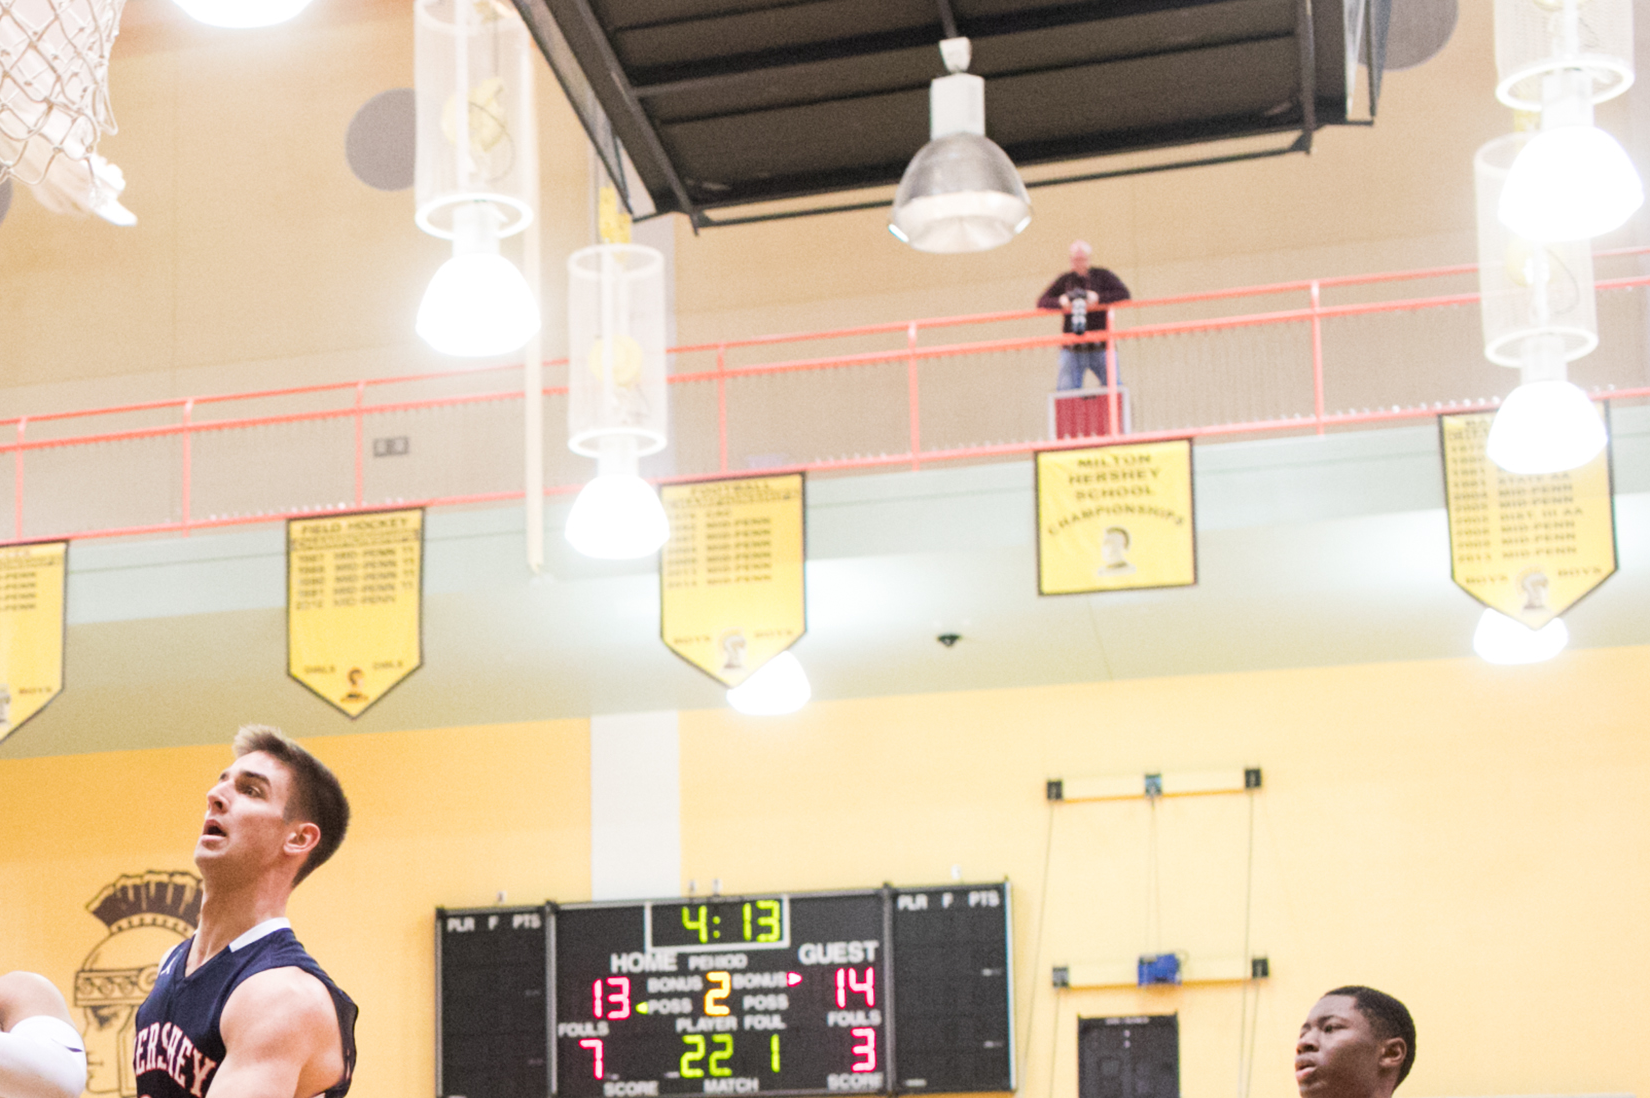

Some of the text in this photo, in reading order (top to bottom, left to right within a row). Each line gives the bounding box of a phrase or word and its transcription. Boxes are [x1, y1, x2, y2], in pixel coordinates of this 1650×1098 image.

[1077, 454, 1151, 468] MILTON
[1068, 467, 1161, 485] HERSHEY
[1075, 485, 1155, 500] SCHOOL
[348, 518, 408, 530] HOCKEY
[1047, 503, 1185, 535] CHAMPIONSHIPS
[897, 890, 1001, 911] PLR F PTS
[447, 914, 541, 933] PLR F PTS
[681, 899, 781, 943] 4:13
[610, 951, 678, 974] HOME
[688, 953, 748, 971] PERIOD
[798, 940, 879, 965] GUEST
[647, 971, 787, 993] BONUS BONUS
[835, 966, 876, 1010] 14
[592, 976, 631, 1020] 13
[648, 993, 789, 1014] POSS POSS
[703, 971, 731, 1016] 2
[557, 1020, 610, 1037] FOULS
[675, 1013, 786, 1033] PLAYER FOUL
[827, 1009, 882, 1027] FOULS
[134, 1022, 217, 1098] ERSHEY
[579, 1038, 605, 1080] 7
[680, 1033, 781, 1078] 22 1
[851, 1027, 877, 1073] 3
[603, 1080, 659, 1098] SCORE
[703, 1077, 759, 1093] MATCH
[827, 1072, 883, 1091] SCORE
